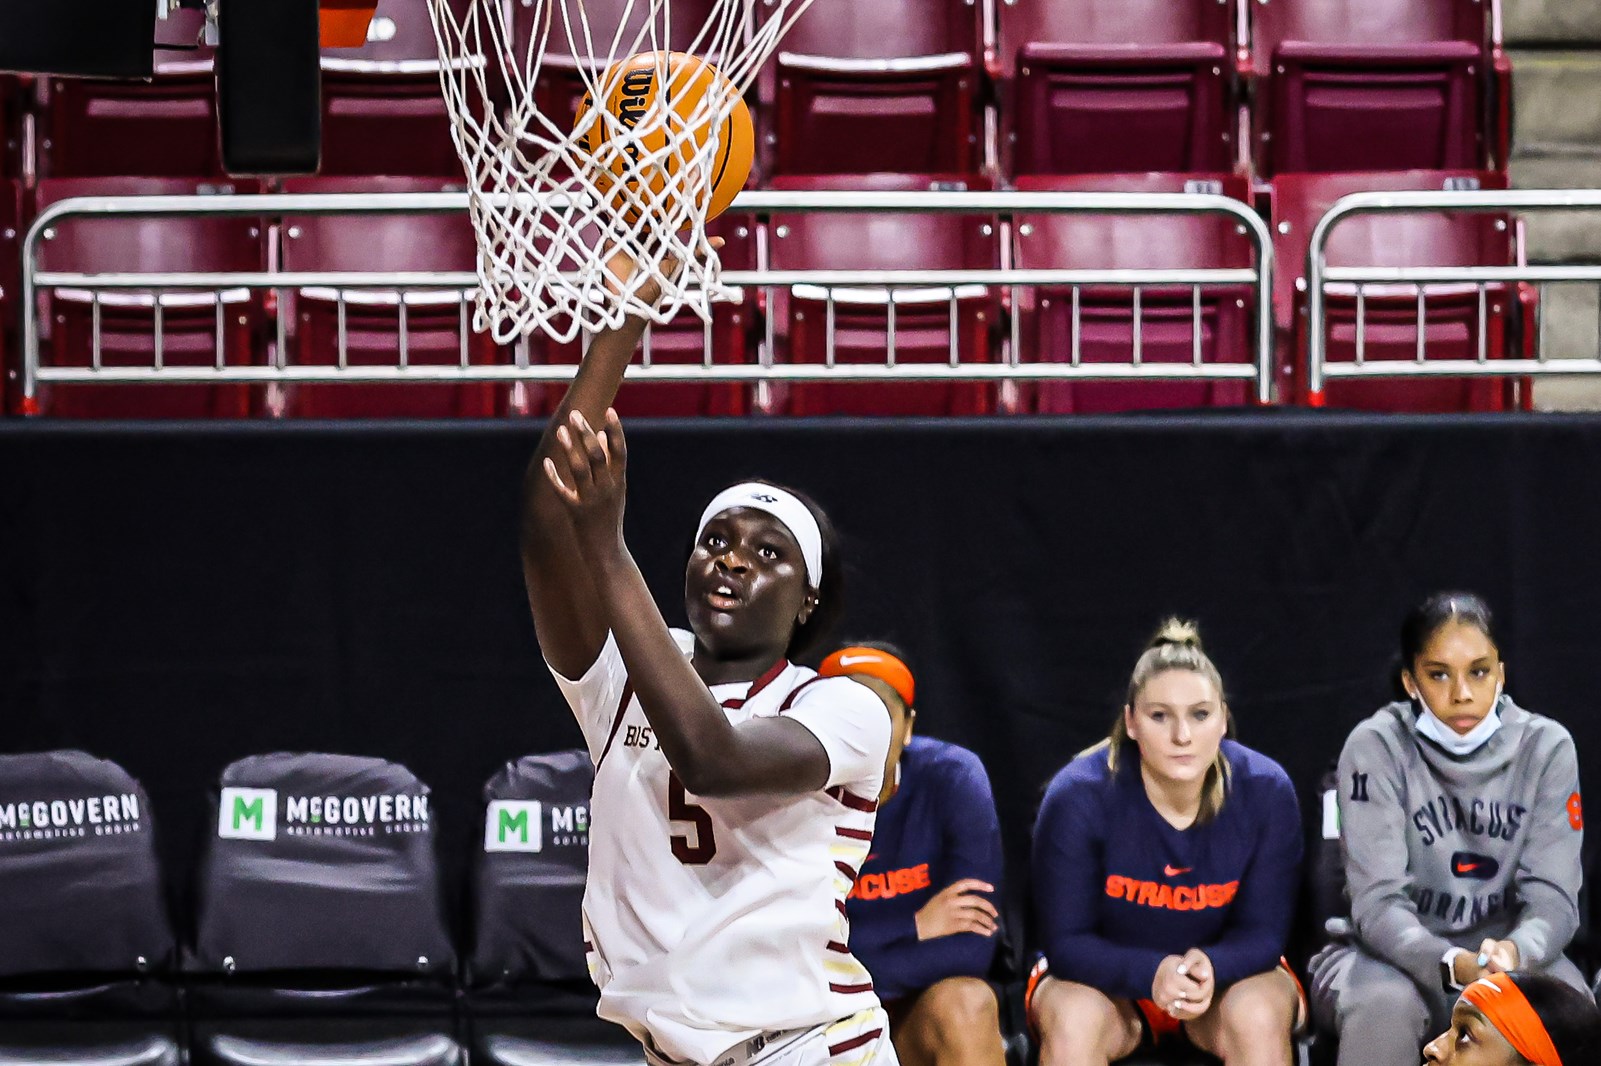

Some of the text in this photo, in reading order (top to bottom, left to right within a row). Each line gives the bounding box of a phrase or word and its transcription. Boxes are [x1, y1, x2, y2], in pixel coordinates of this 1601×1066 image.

[233, 796, 264, 832] M
[498, 808, 529, 843] M
[668, 769, 717, 865] 5
